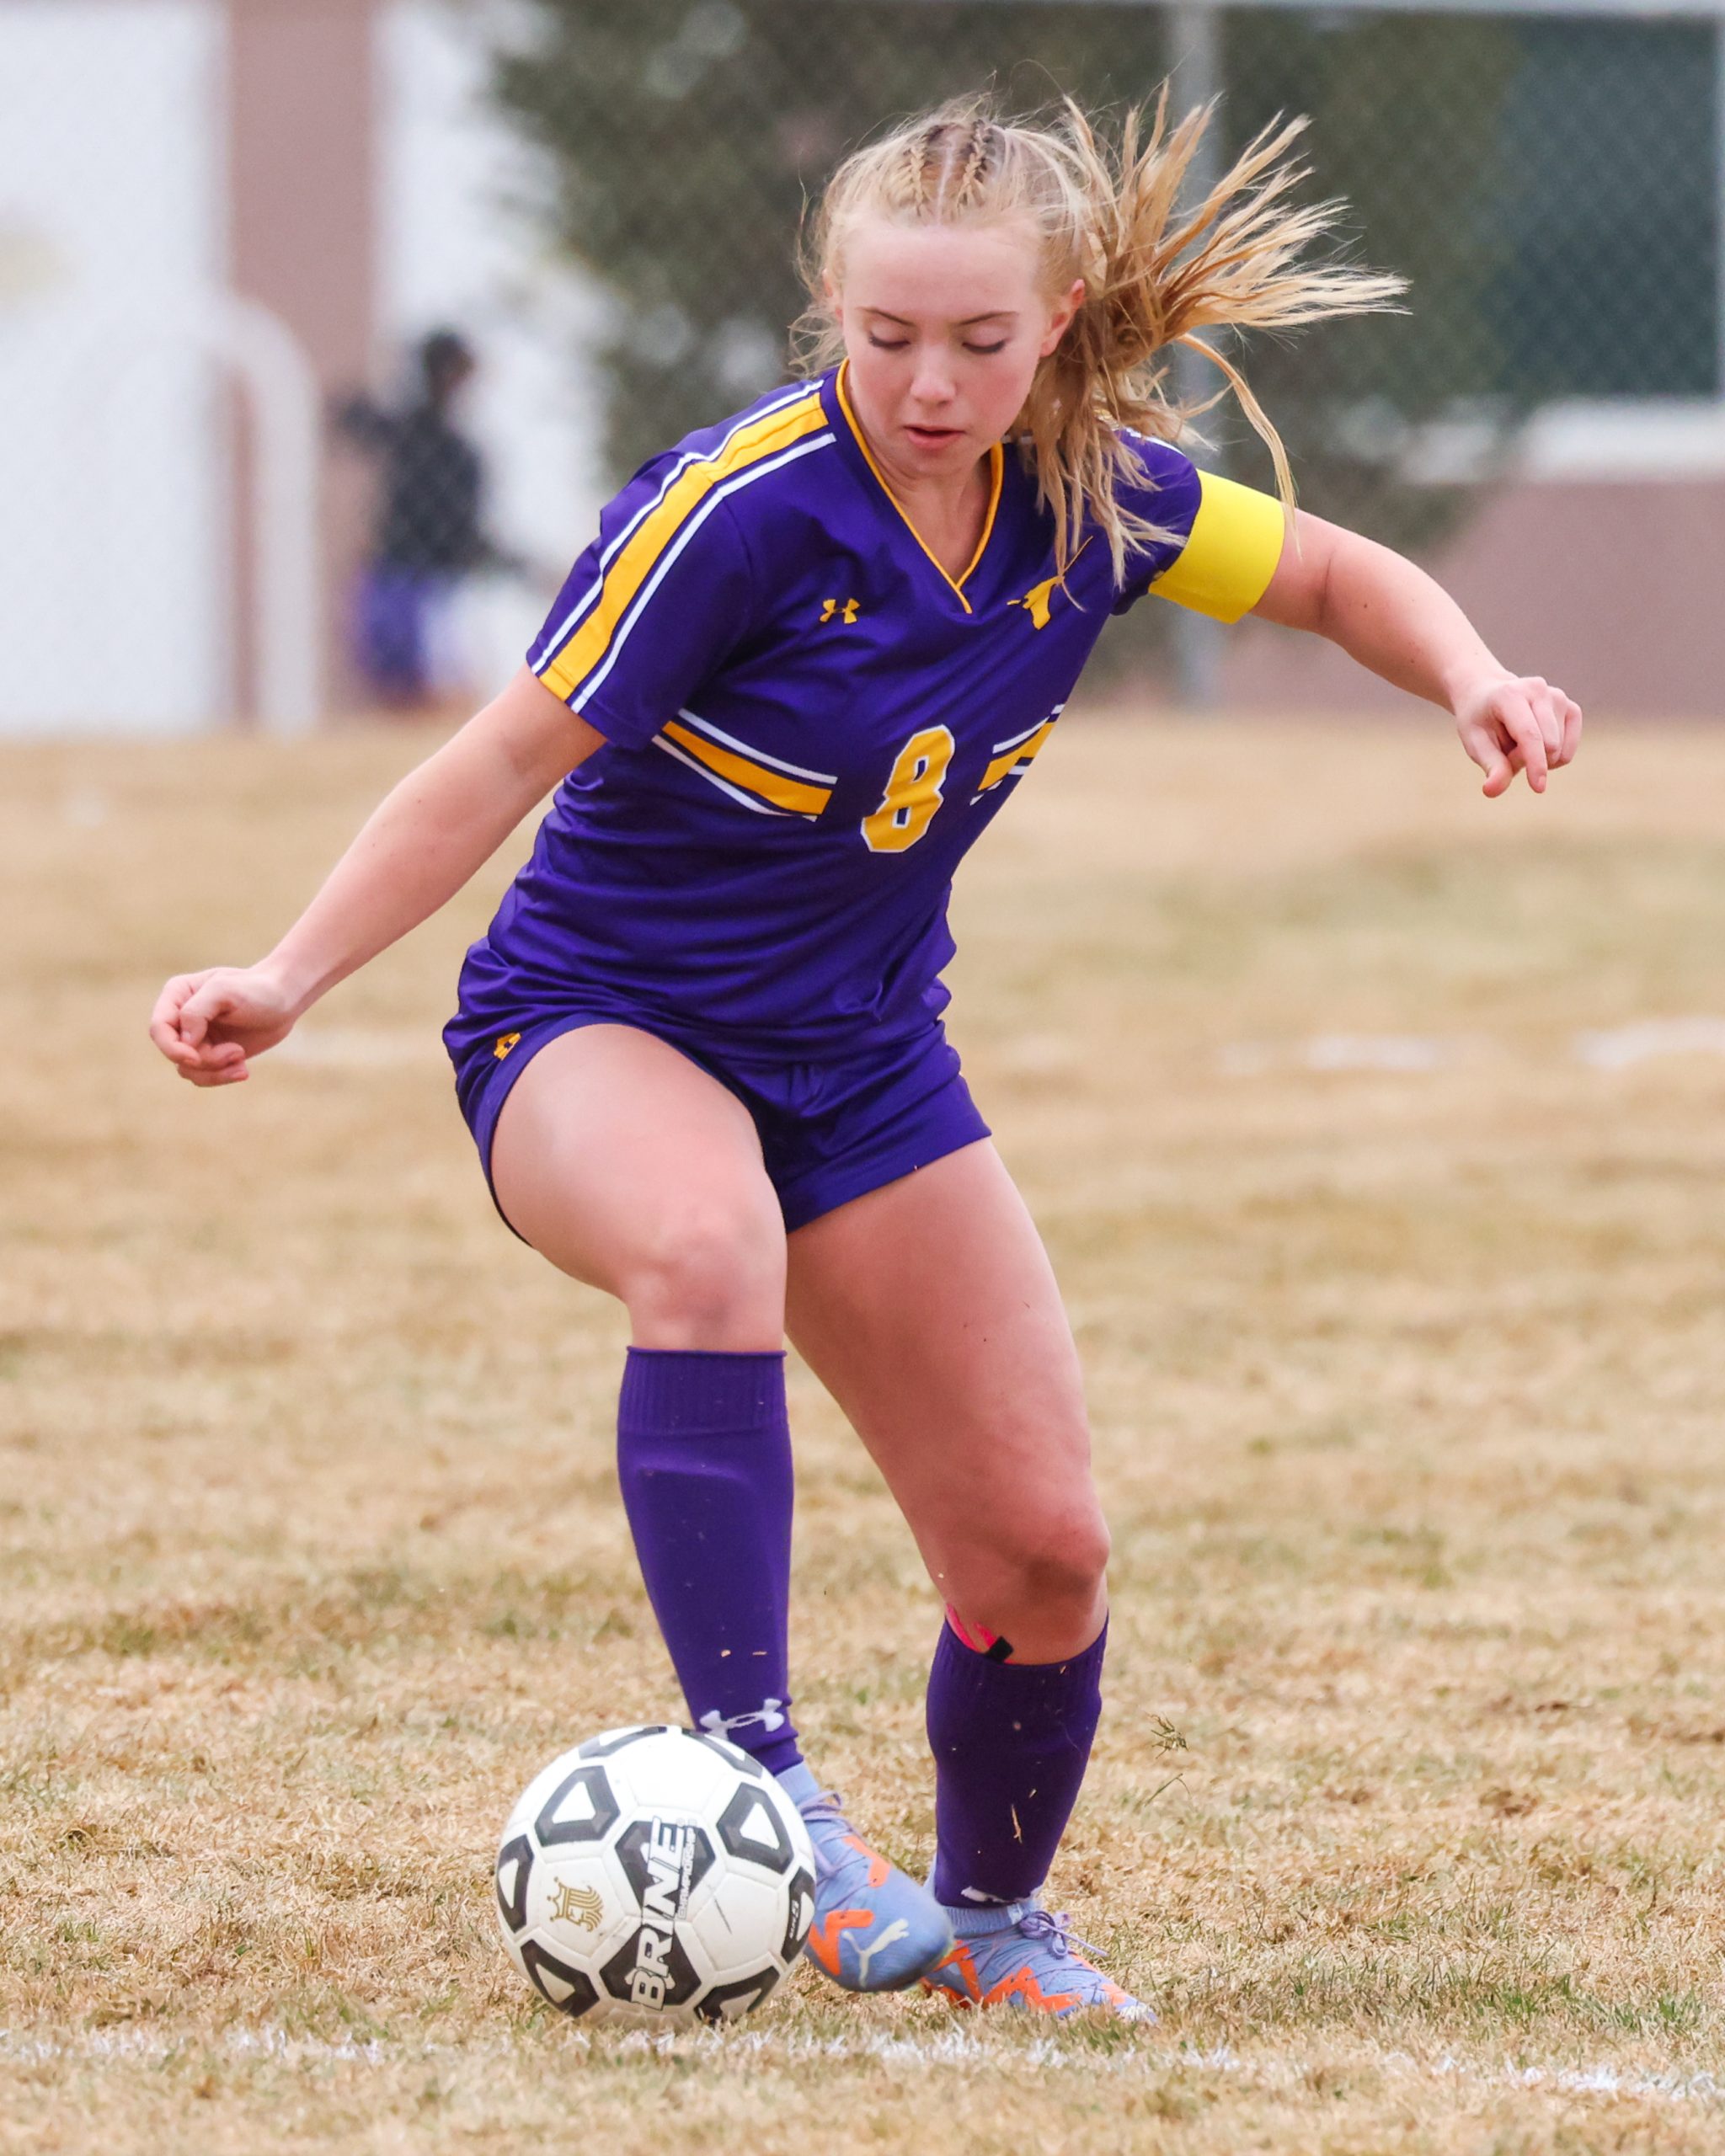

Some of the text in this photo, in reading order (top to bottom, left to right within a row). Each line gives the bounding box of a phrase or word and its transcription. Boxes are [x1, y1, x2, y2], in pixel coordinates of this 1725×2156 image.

[860, 724, 955, 853] 8
[631, 1816, 685, 2011] BRINE
[676, 1825, 697, 1920] CHAMPIONSHIP
